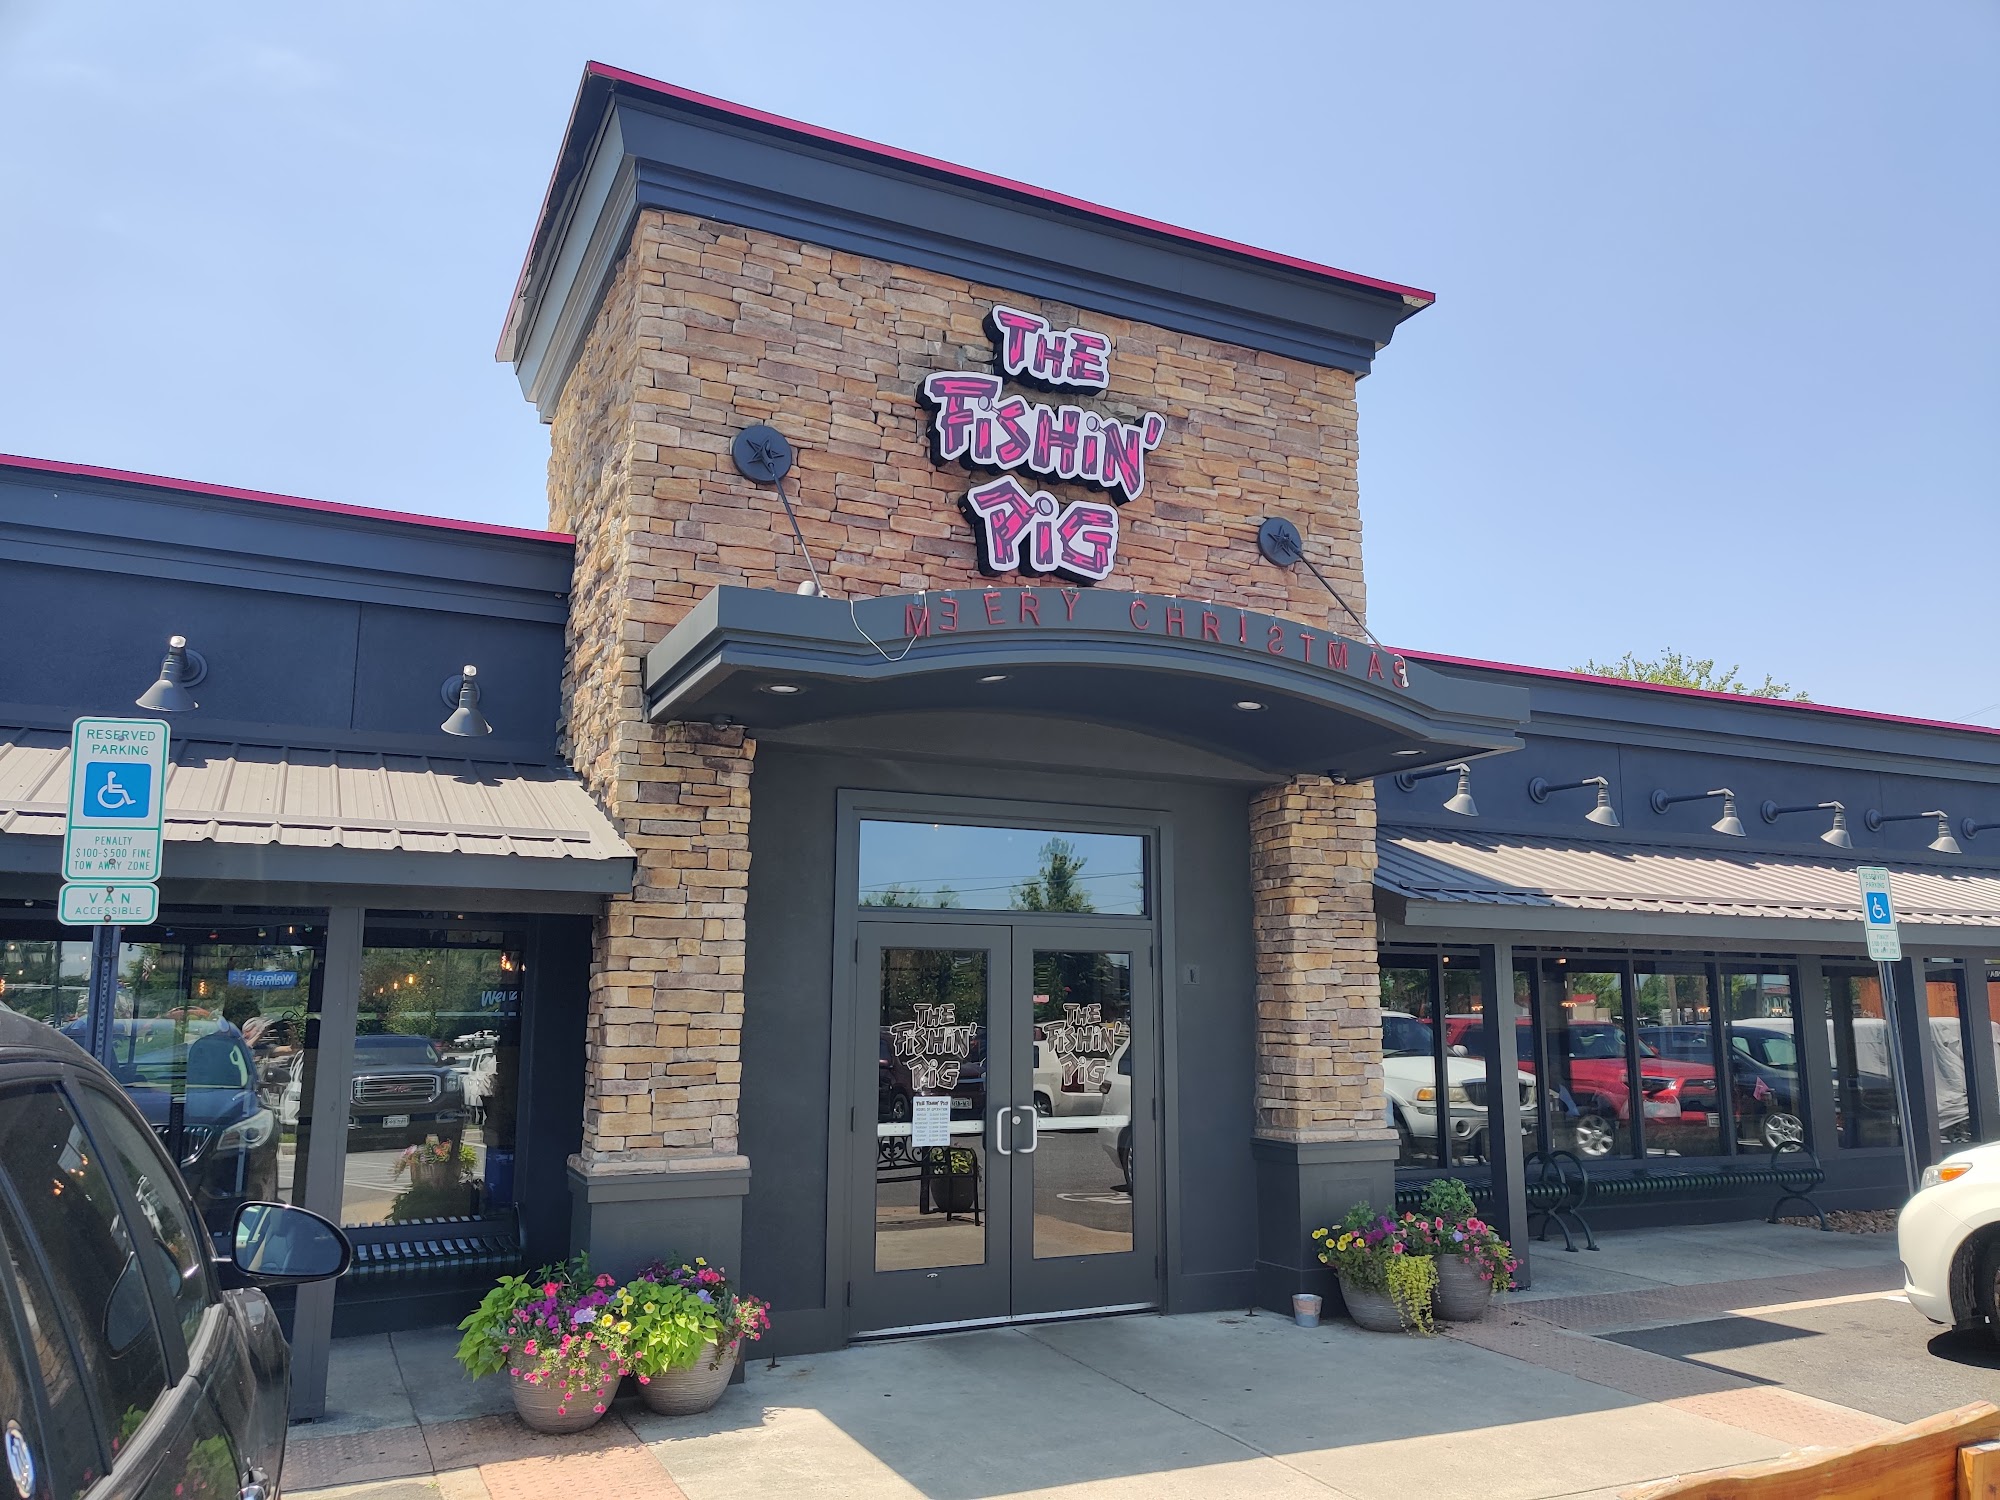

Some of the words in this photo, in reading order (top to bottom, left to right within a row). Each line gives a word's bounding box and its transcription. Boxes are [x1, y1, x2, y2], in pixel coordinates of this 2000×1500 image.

[995, 307, 1109, 385] THE
[1128, 599, 1408, 688] CHRISTMAS
[86, 729, 156, 742] RESERVED
[91, 744, 150, 756] PARKING
[94, 836, 133, 846] PENALTY
[75, 848, 127, 859] $100-$500
[132, 849, 151, 859] FINE
[74, 861, 92, 870] TOW
[98, 861, 122, 871] AWAY
[128, 861, 150, 871] ZONE
[89, 893, 131, 904] VAN
[75, 906, 142, 915] ACCESSIBLE
[914, 1003, 956, 1027] THE
[1063, 1003, 1102, 1026] THE
